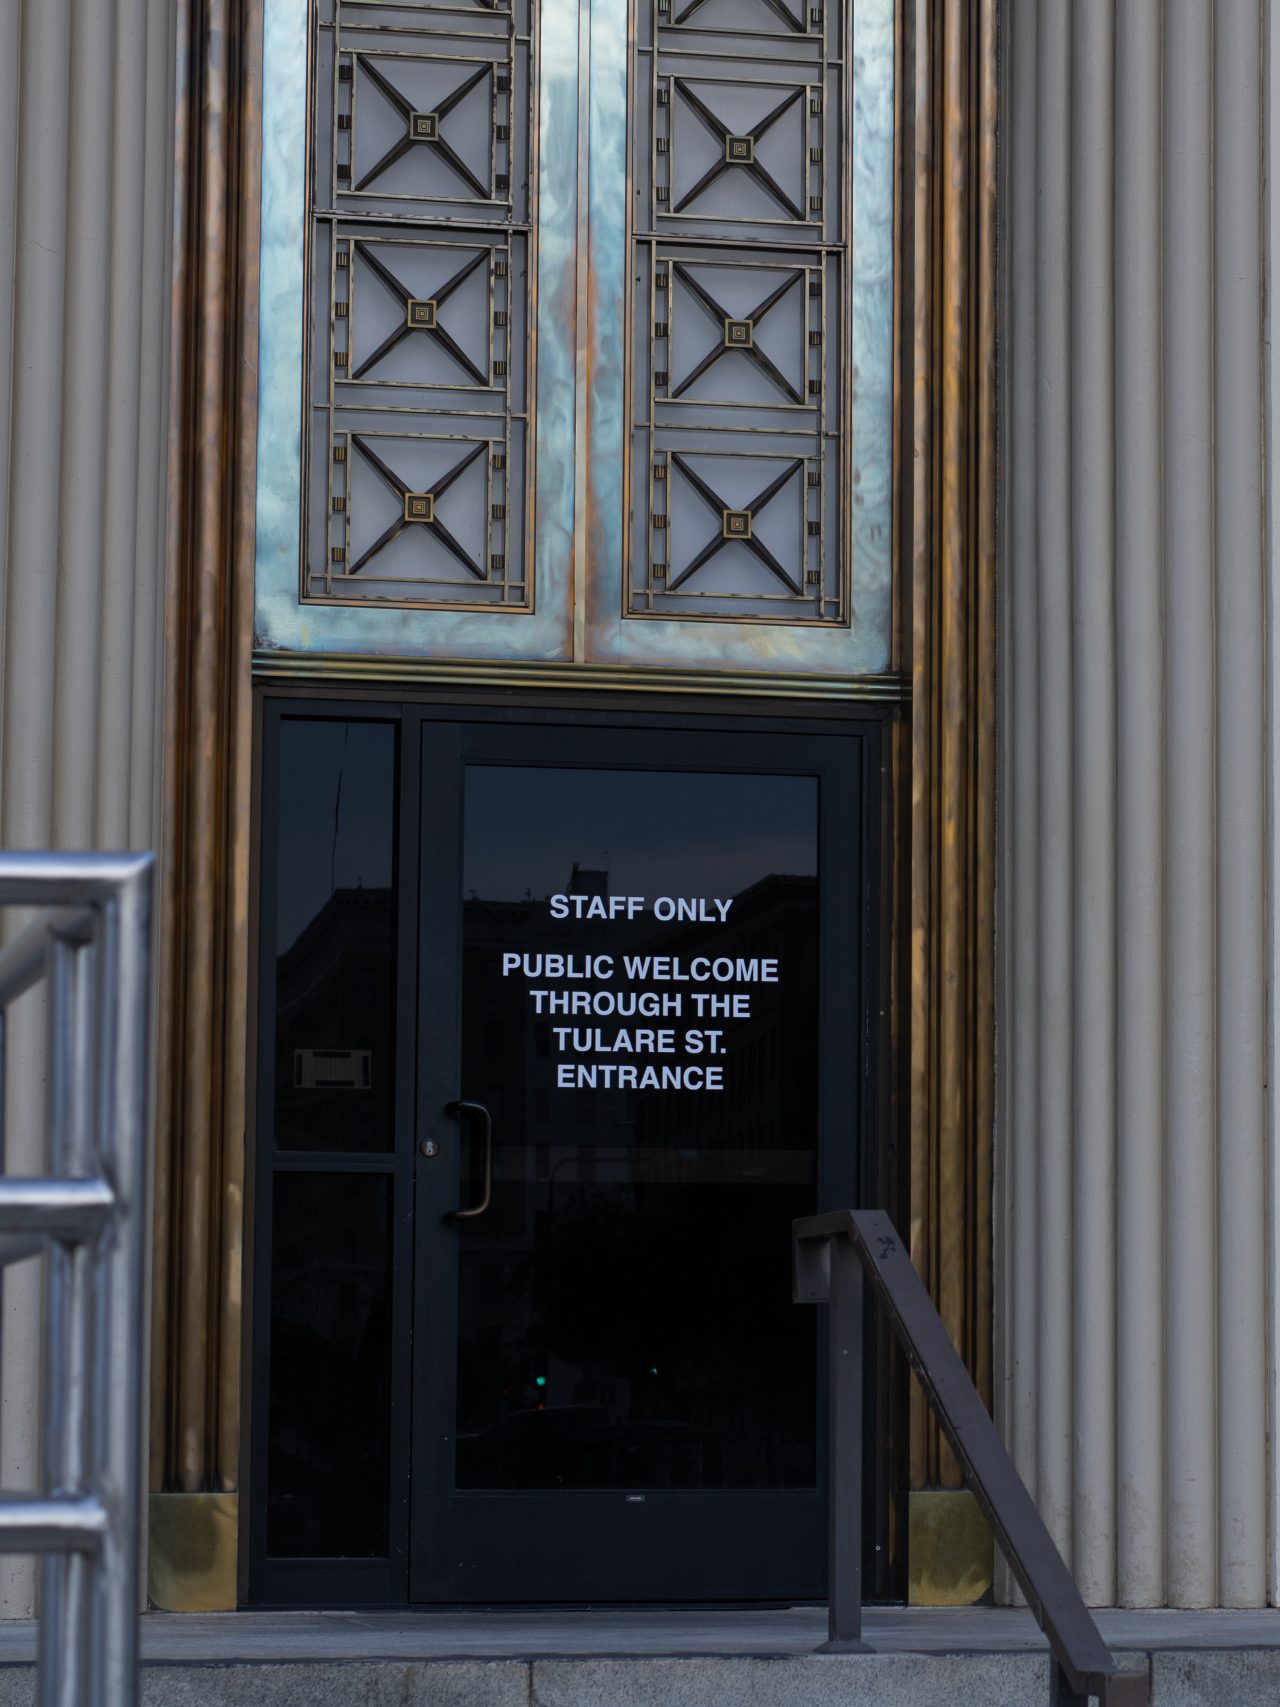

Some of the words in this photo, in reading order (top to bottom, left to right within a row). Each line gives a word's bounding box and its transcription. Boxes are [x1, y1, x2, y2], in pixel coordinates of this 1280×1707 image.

[550, 894, 645, 920] STAFF
[653, 896, 733, 922] ONLY
[502, 953, 614, 979] PUBLIC
[623, 956, 779, 982] WELCOME
[529, 990, 682, 1017] THROUGH
[691, 993, 751, 1018] THE
[552, 1027, 675, 1053] TULARE
[685, 1029, 727, 1054] ST.
[557, 1064, 724, 1090] ENTRANCE
